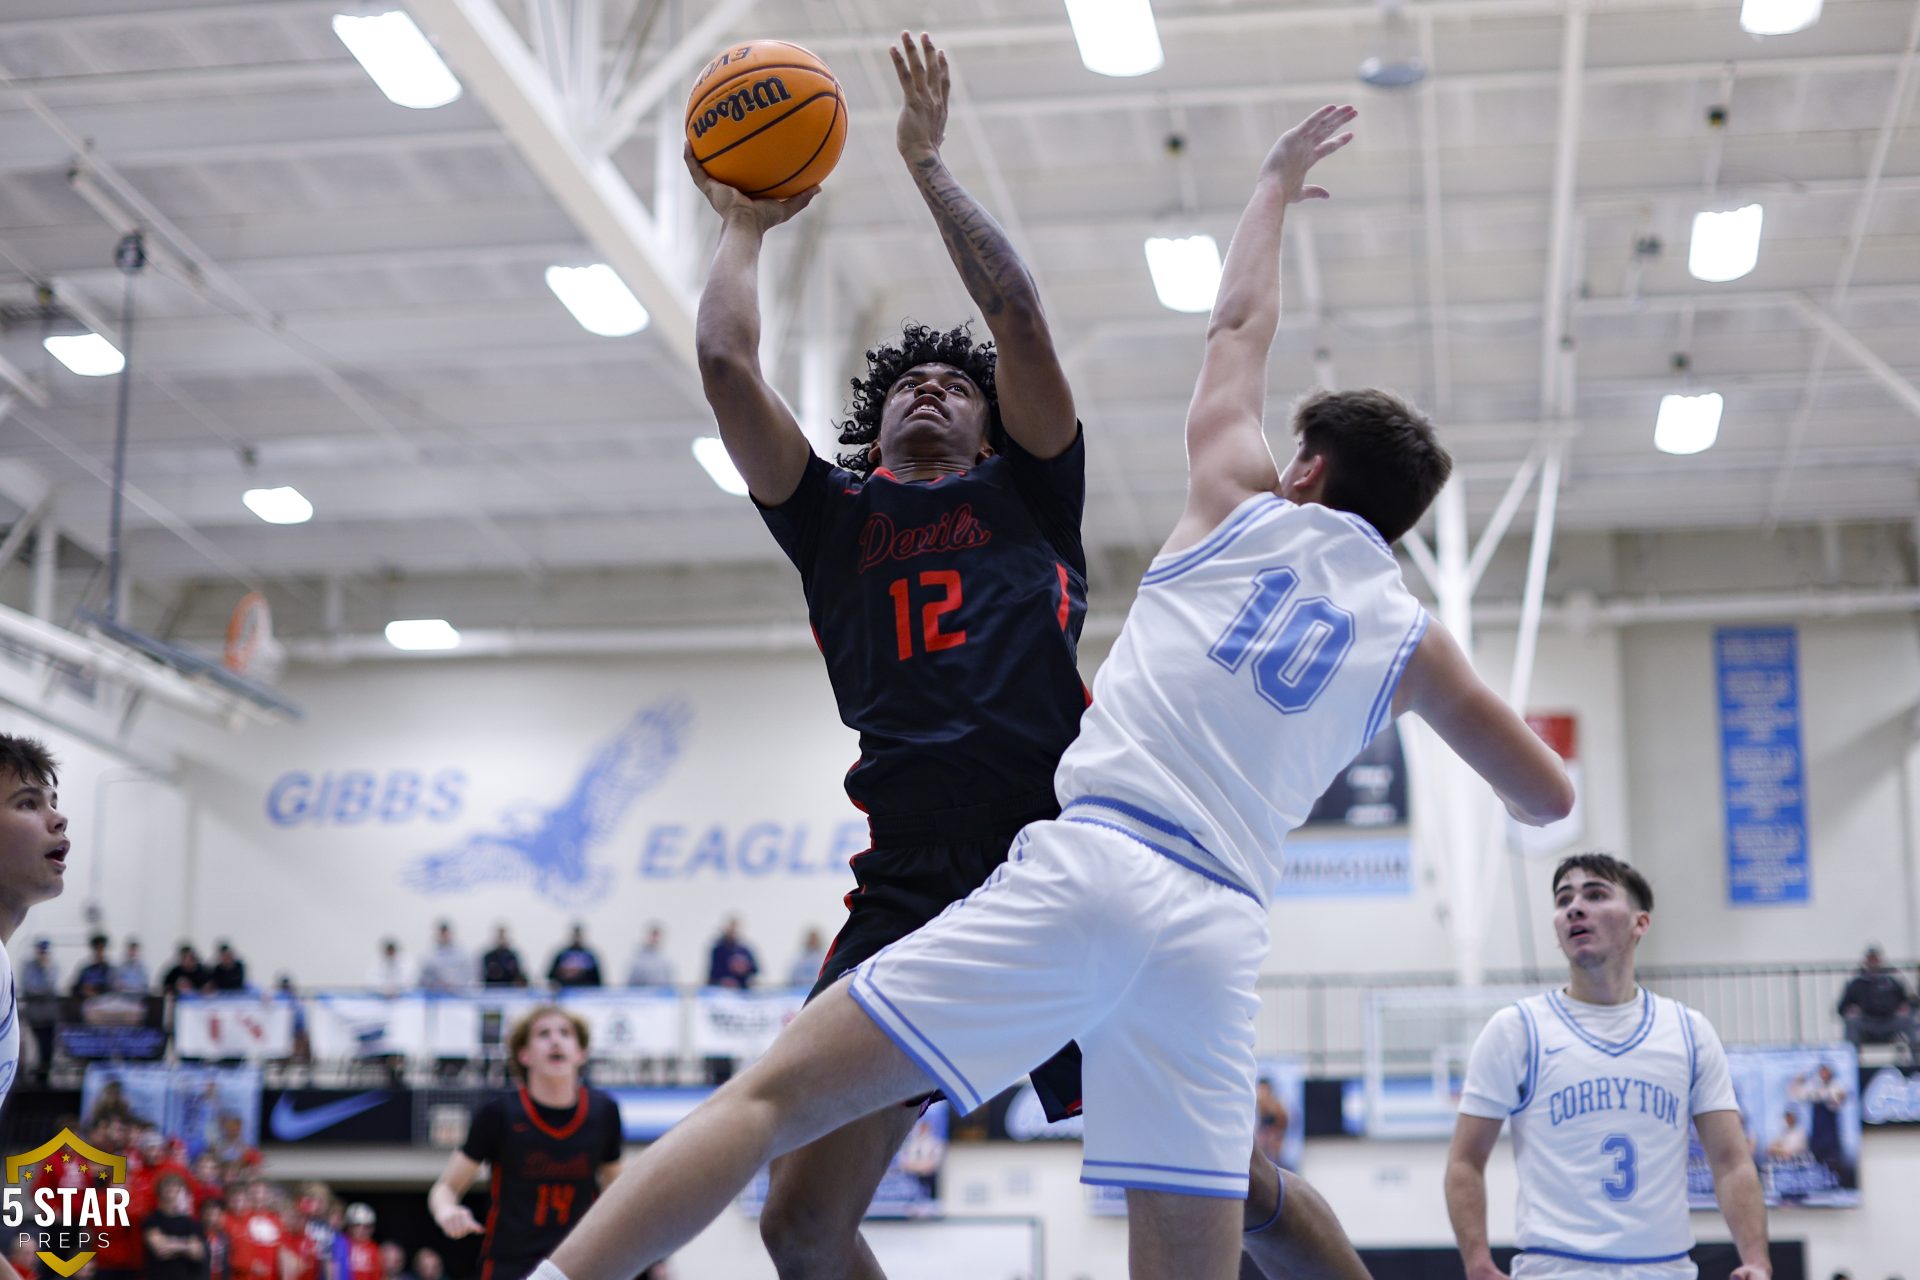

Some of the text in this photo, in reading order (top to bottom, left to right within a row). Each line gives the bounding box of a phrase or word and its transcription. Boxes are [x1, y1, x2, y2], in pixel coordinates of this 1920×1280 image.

[691, 76, 792, 138] Wilson
[858, 503, 992, 574] Devils
[889, 569, 967, 661] 12
[1207, 565, 1356, 715] 10
[266, 768, 468, 827] GIBBS
[1550, 1077, 1680, 1129] CORRYTON
[1600, 1133, 1638, 1202] 3
[533, 1183, 577, 1227] 14
